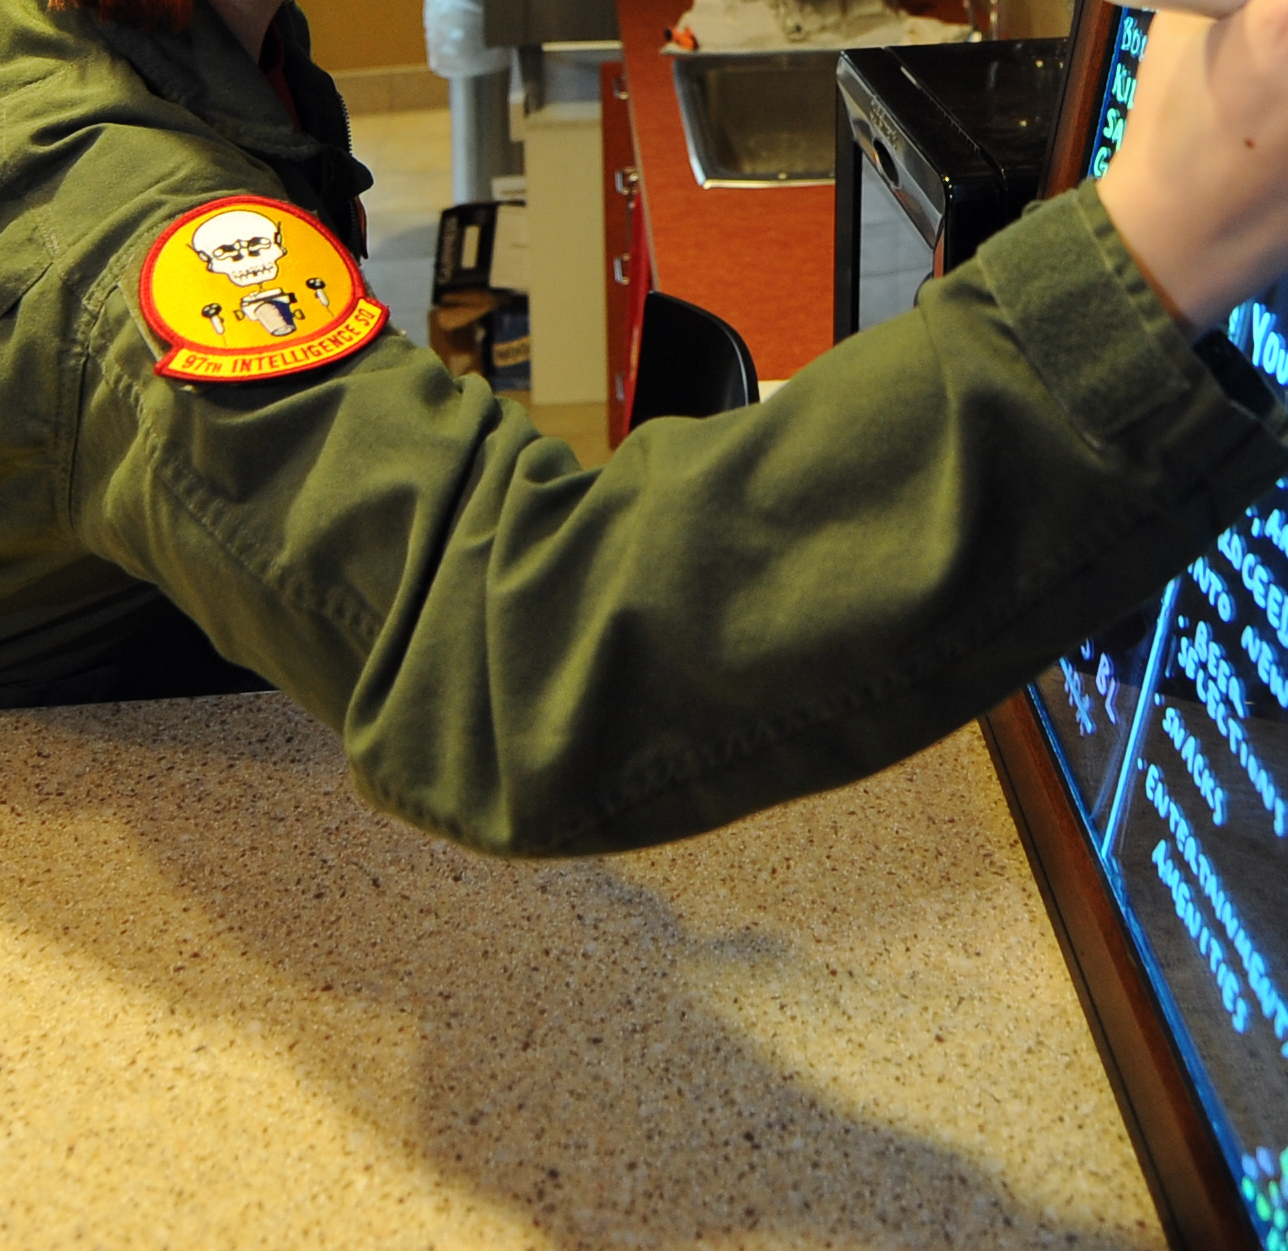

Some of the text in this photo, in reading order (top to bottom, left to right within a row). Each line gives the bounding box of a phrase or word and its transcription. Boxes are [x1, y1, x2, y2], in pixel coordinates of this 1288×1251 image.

[181, 307, 377, 373] 97TH INTELLIGENCE SQ
[1194, 620, 1248, 719] BEER
[1162, 707, 1227, 827] SNACKS
[1177, 637, 1288, 837] SELECTIONS
[1152, 839, 1247, 1035] AMENITIES
